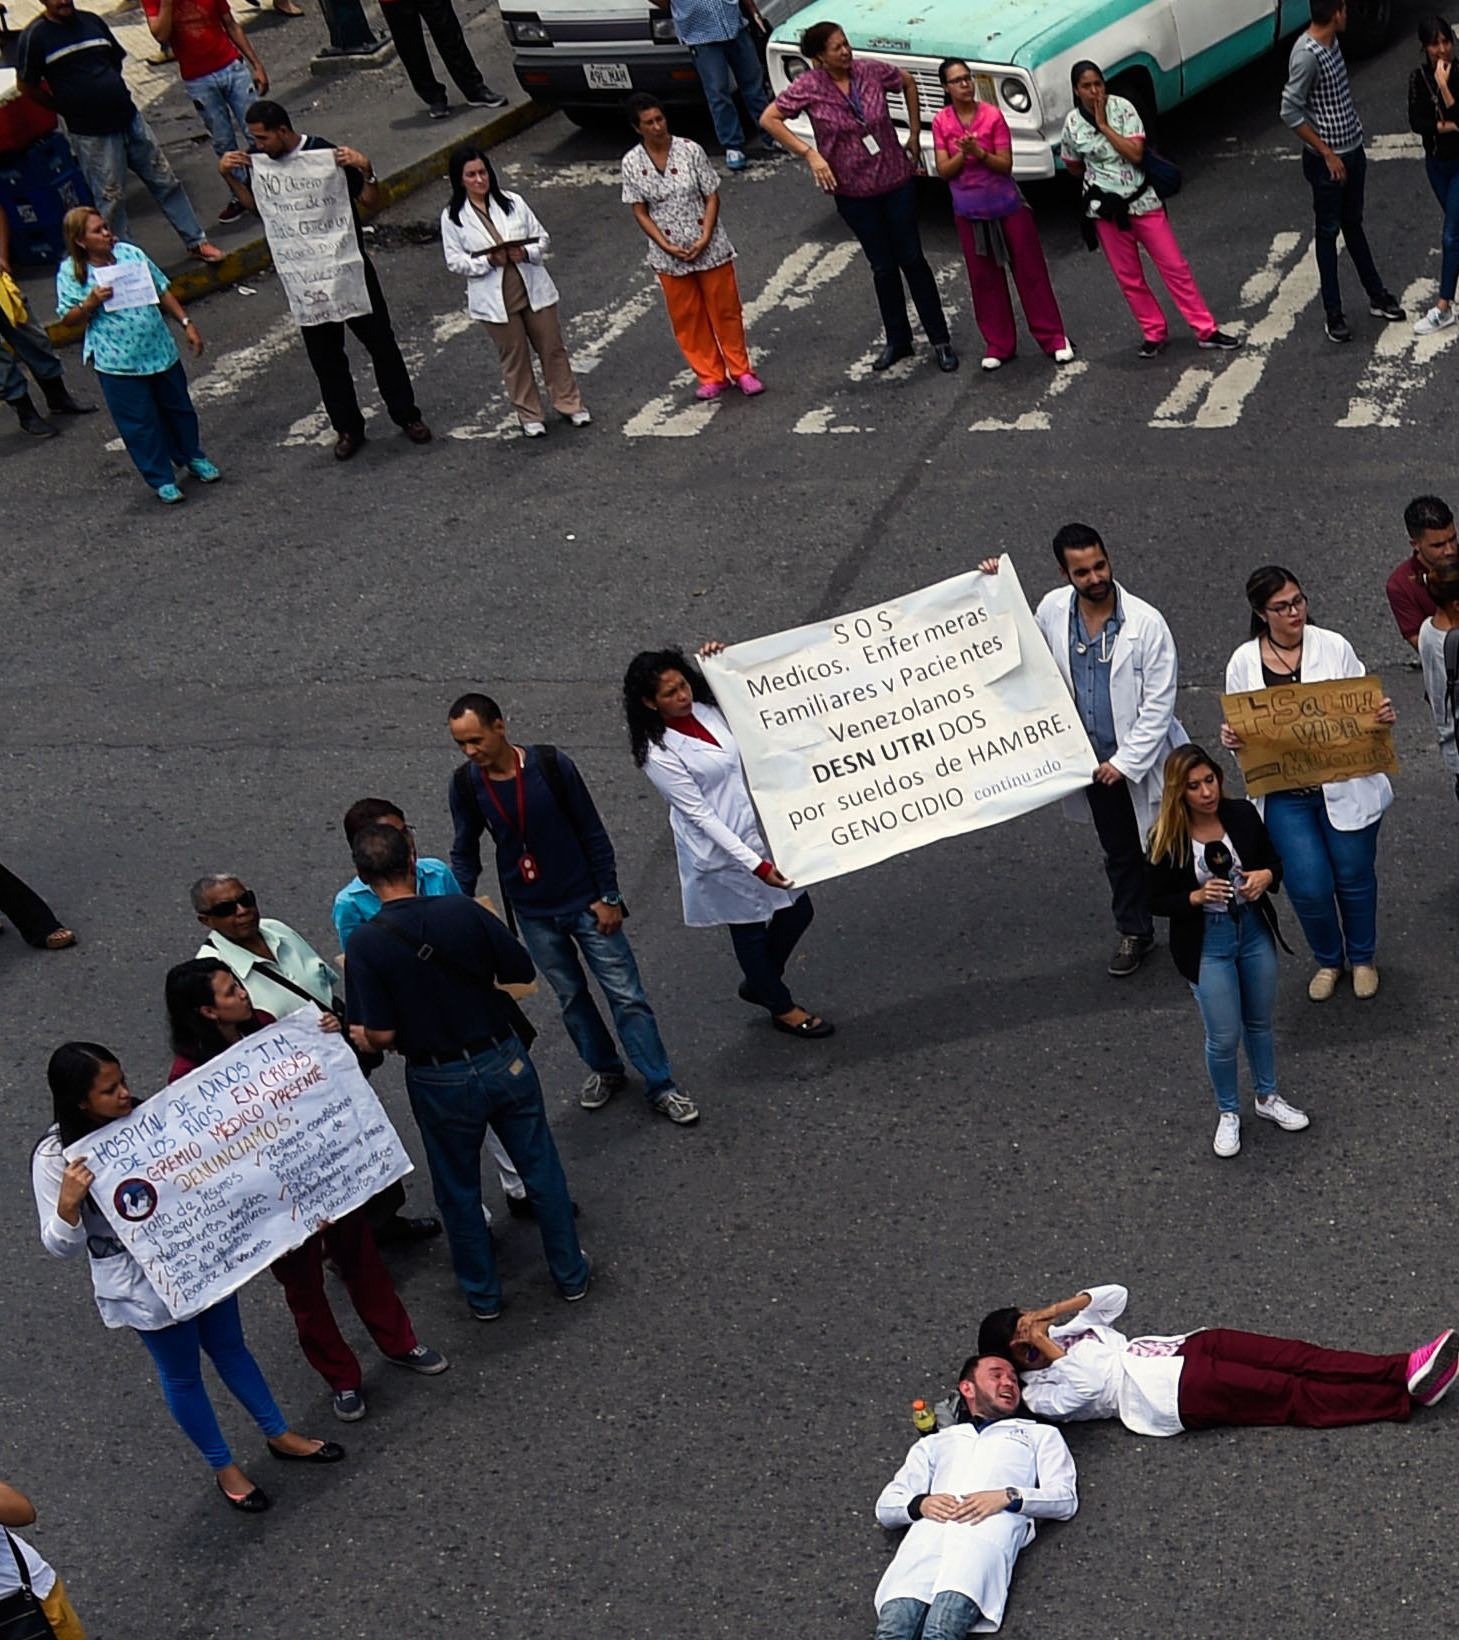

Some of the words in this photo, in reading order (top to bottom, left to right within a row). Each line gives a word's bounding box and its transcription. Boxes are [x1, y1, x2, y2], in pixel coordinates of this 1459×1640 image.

[746, 656, 850, 698] Medicos.
[759, 681, 878, 730] Familiares
[899, 633, 1004, 687] Pacientes
[828, 682, 976, 744] Venezolanos
[788, 803, 827, 831] por
[837, 768, 925, 812] sueldos
[934, 754, 964, 778] de
[967, 711, 1073, 767] HAMBRE.
[92, 1113, 167, 1166] HOSPITAL
[169, 1095, 197, 1119] DE
[113, 1152, 146, 1176] DE
[147, 1135, 176, 1158] LOS
[230, 1082, 259, 1105] EN
[259, 1050, 311, 1088] CRISIS
[146, 1140, 203, 1182] GREMIO
[262, 1063, 328, 1110] PRESENTE
[332, 1119, 346, 1133] de
[177, 1201, 197, 1217] de
[201, 1241, 215, 1254] no
